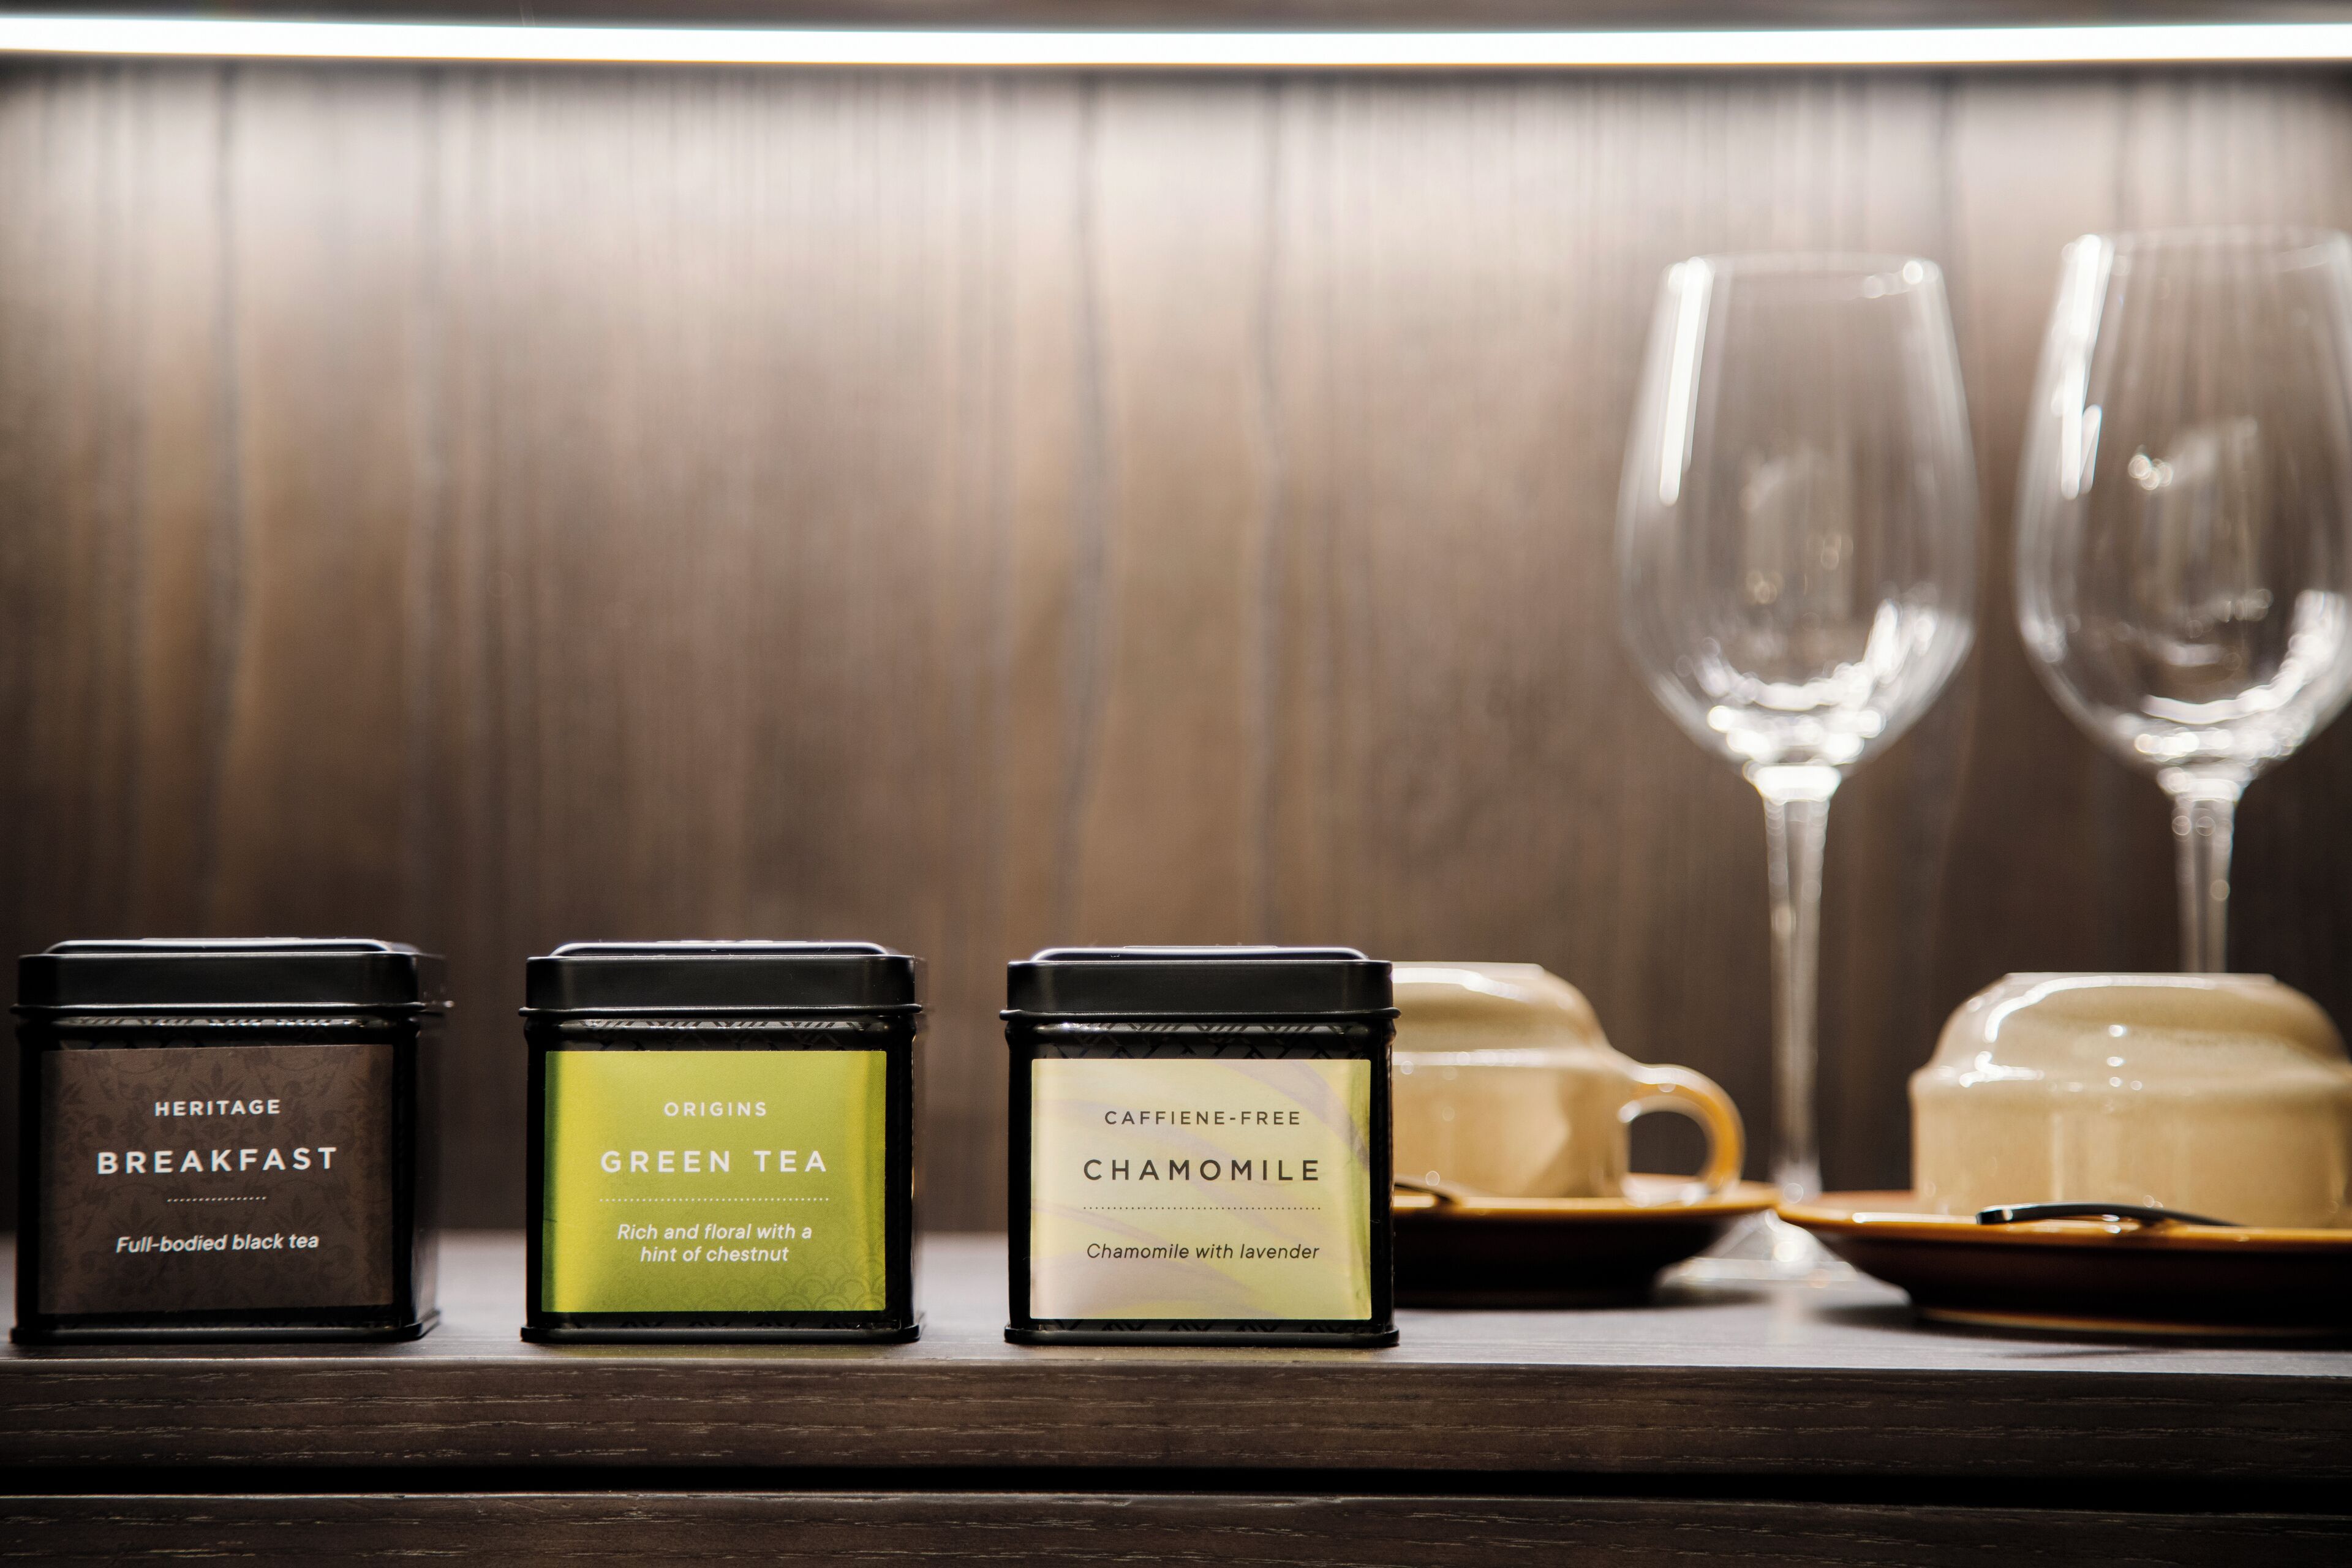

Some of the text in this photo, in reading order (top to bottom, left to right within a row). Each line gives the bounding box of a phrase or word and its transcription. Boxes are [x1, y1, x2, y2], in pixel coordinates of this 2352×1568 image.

[156, 1099, 281, 1117] HERITAGE
[664, 1102, 767, 1117] ORIGINS
[1105, 1111, 1300, 1126] CAFFIENE-FREE
[99, 1147, 337, 1175] BREAKFAST
[601, 1151, 827, 1174] GREEN TEA
[1084, 1159, 1319, 1182] CHAMOMILE
[618, 1224, 813, 1240] Rich and floral with a
[116, 1234, 320, 1254] Full-bodied black tea
[1087, 1244, 1321, 1259] Chamomile with lavender
[641, 1246, 790, 1263] hint of chestnut
